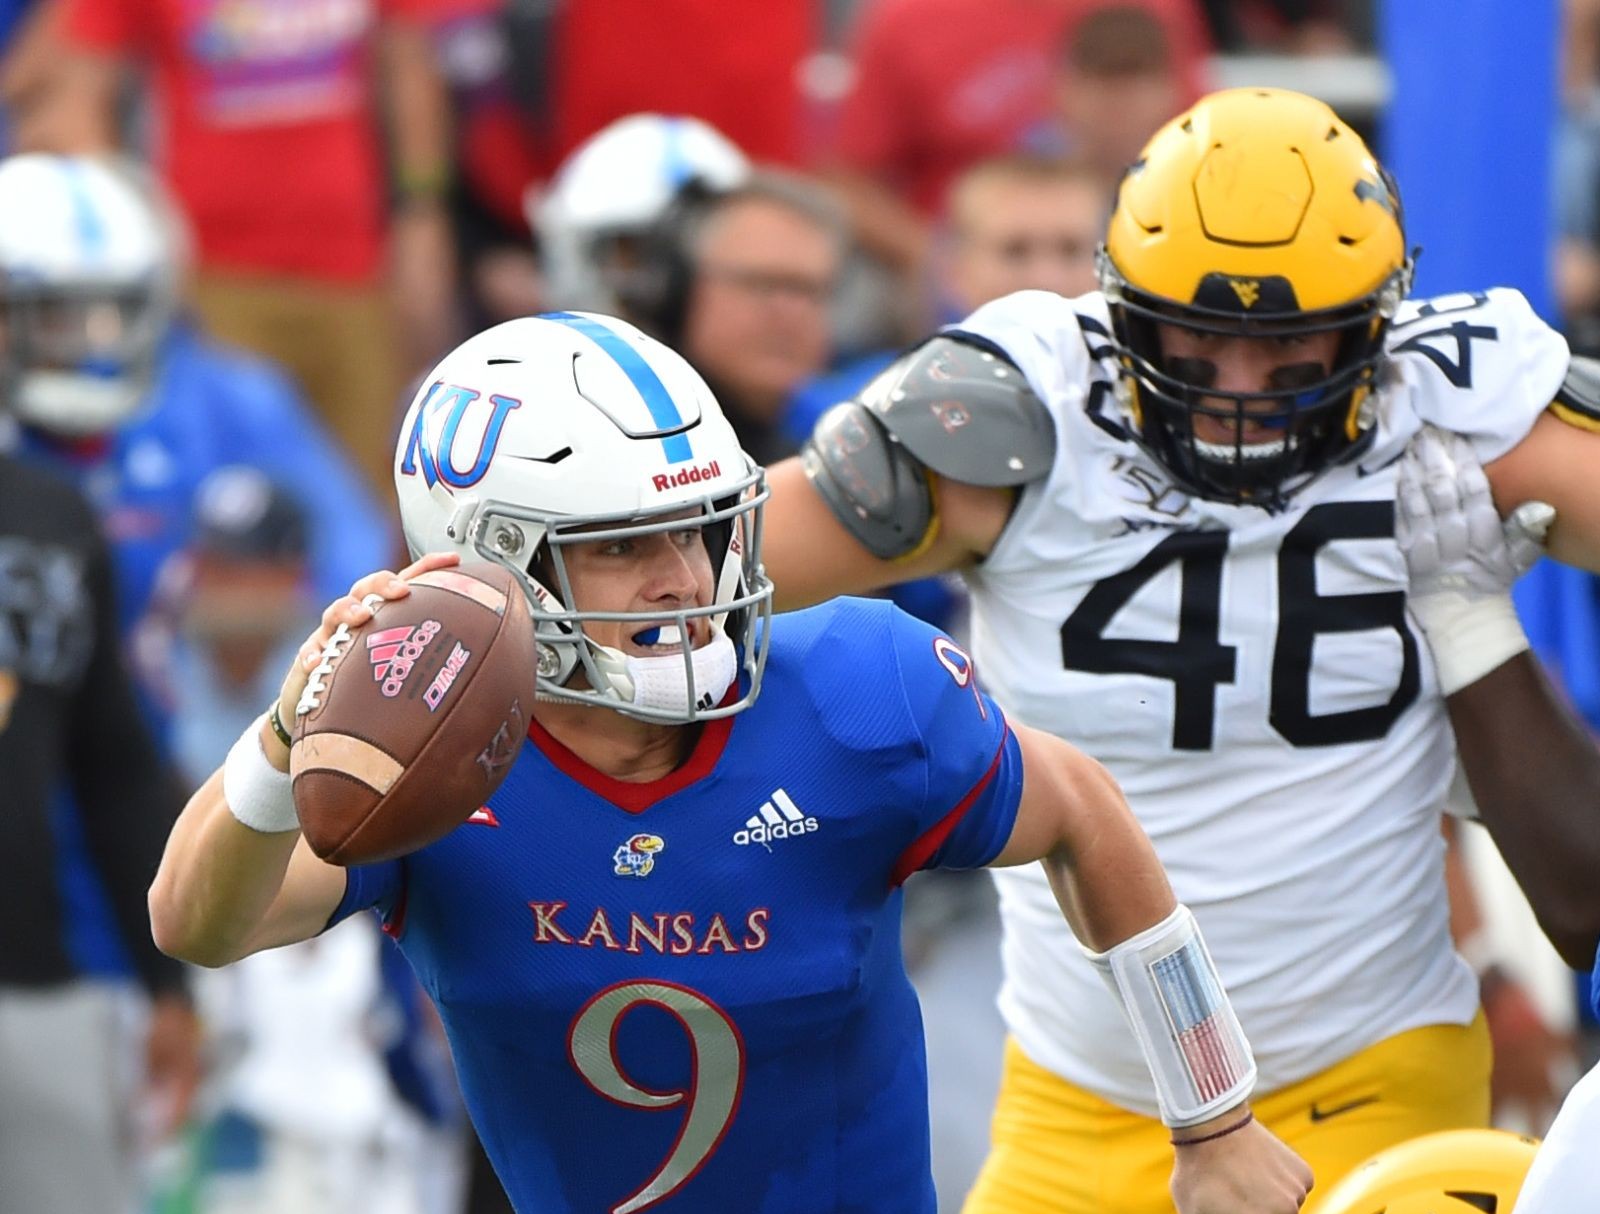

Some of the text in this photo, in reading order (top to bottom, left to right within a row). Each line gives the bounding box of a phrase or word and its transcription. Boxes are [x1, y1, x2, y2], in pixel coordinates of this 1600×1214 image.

[401, 377, 522, 496] KU
[652, 460, 721, 492] Riddell
[381, 620, 441, 697] adidas
[1061, 501, 1422, 751] 46
[423, 641, 470, 712] DIME
[733, 815, 819, 846] adidas
[529, 901, 771, 956] KANSAS
